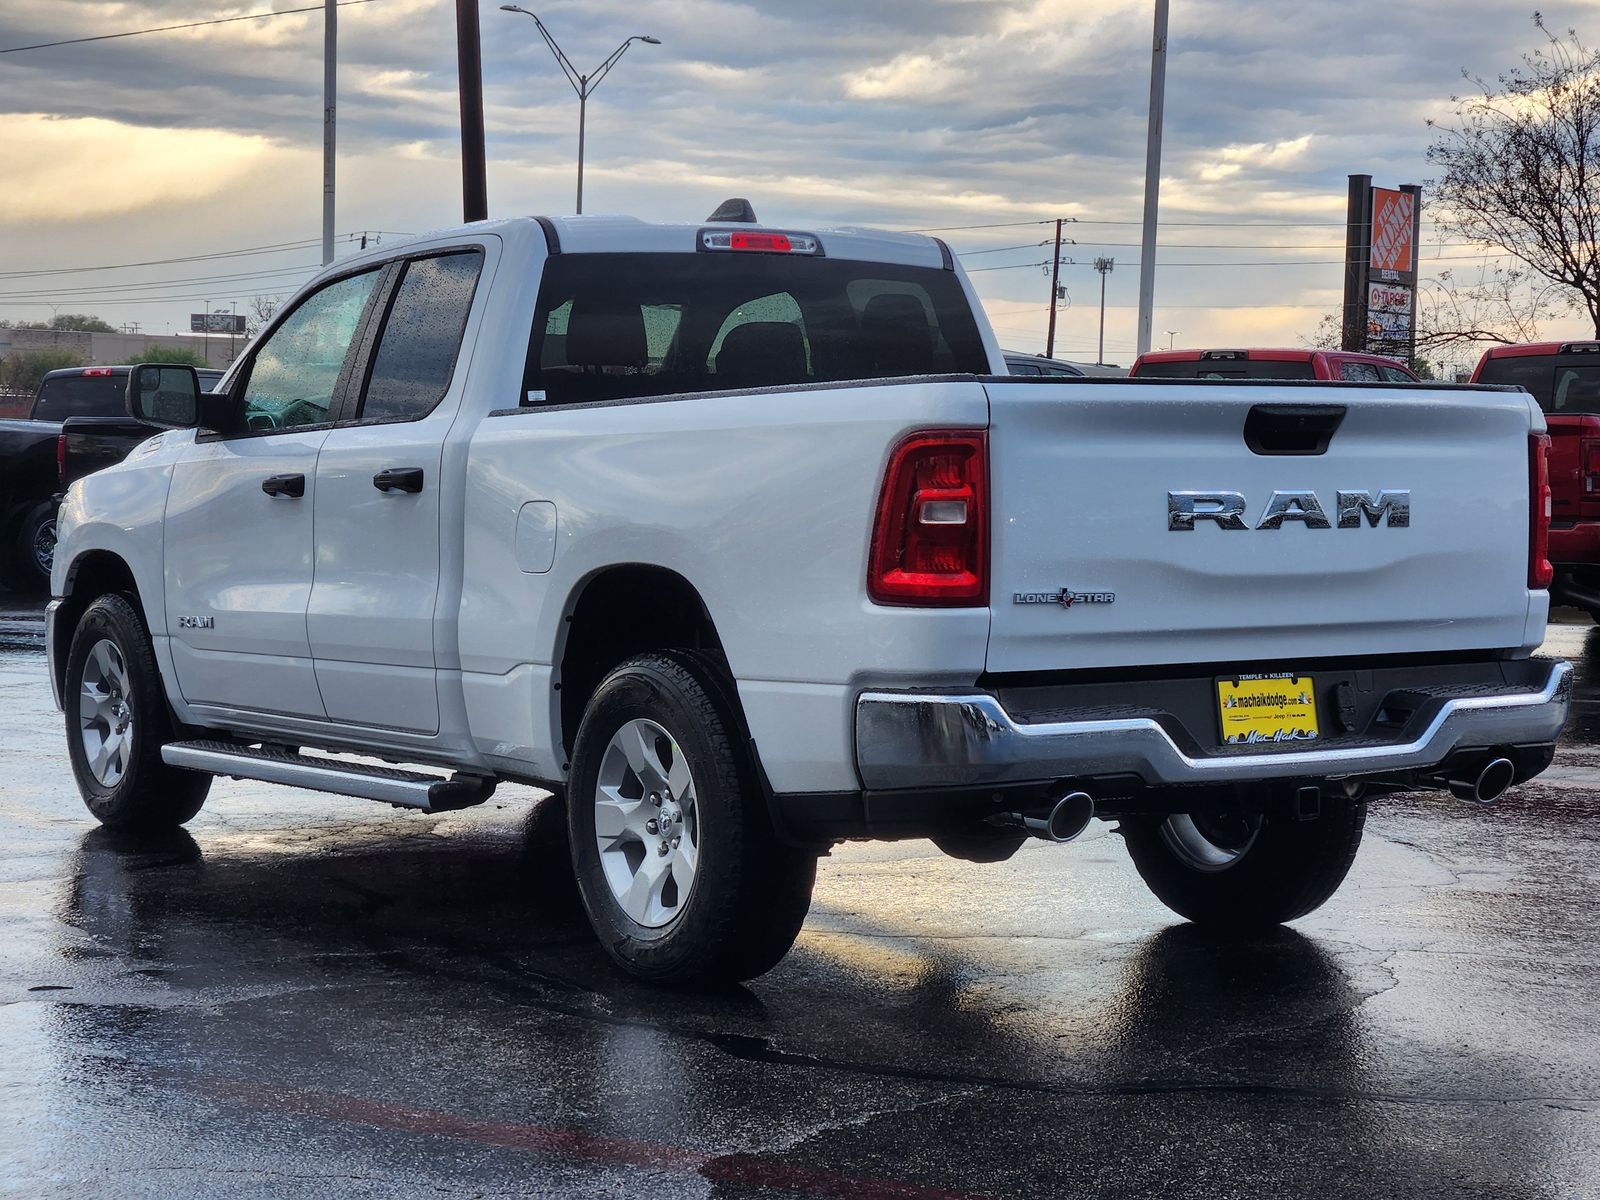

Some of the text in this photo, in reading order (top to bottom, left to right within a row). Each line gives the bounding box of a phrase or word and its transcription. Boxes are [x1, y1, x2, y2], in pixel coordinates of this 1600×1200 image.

[1378, 196, 1394, 229] THE
[1373, 193, 1411, 268] HOME
[1387, 219, 1411, 270] DEPOT
[1167, 490, 1411, 531] RAM
[1014, 593, 1115, 604] LONE STAR
[178, 615, 214, 629] RAM
[1237, 692, 1298, 709] machaikdodge.com
